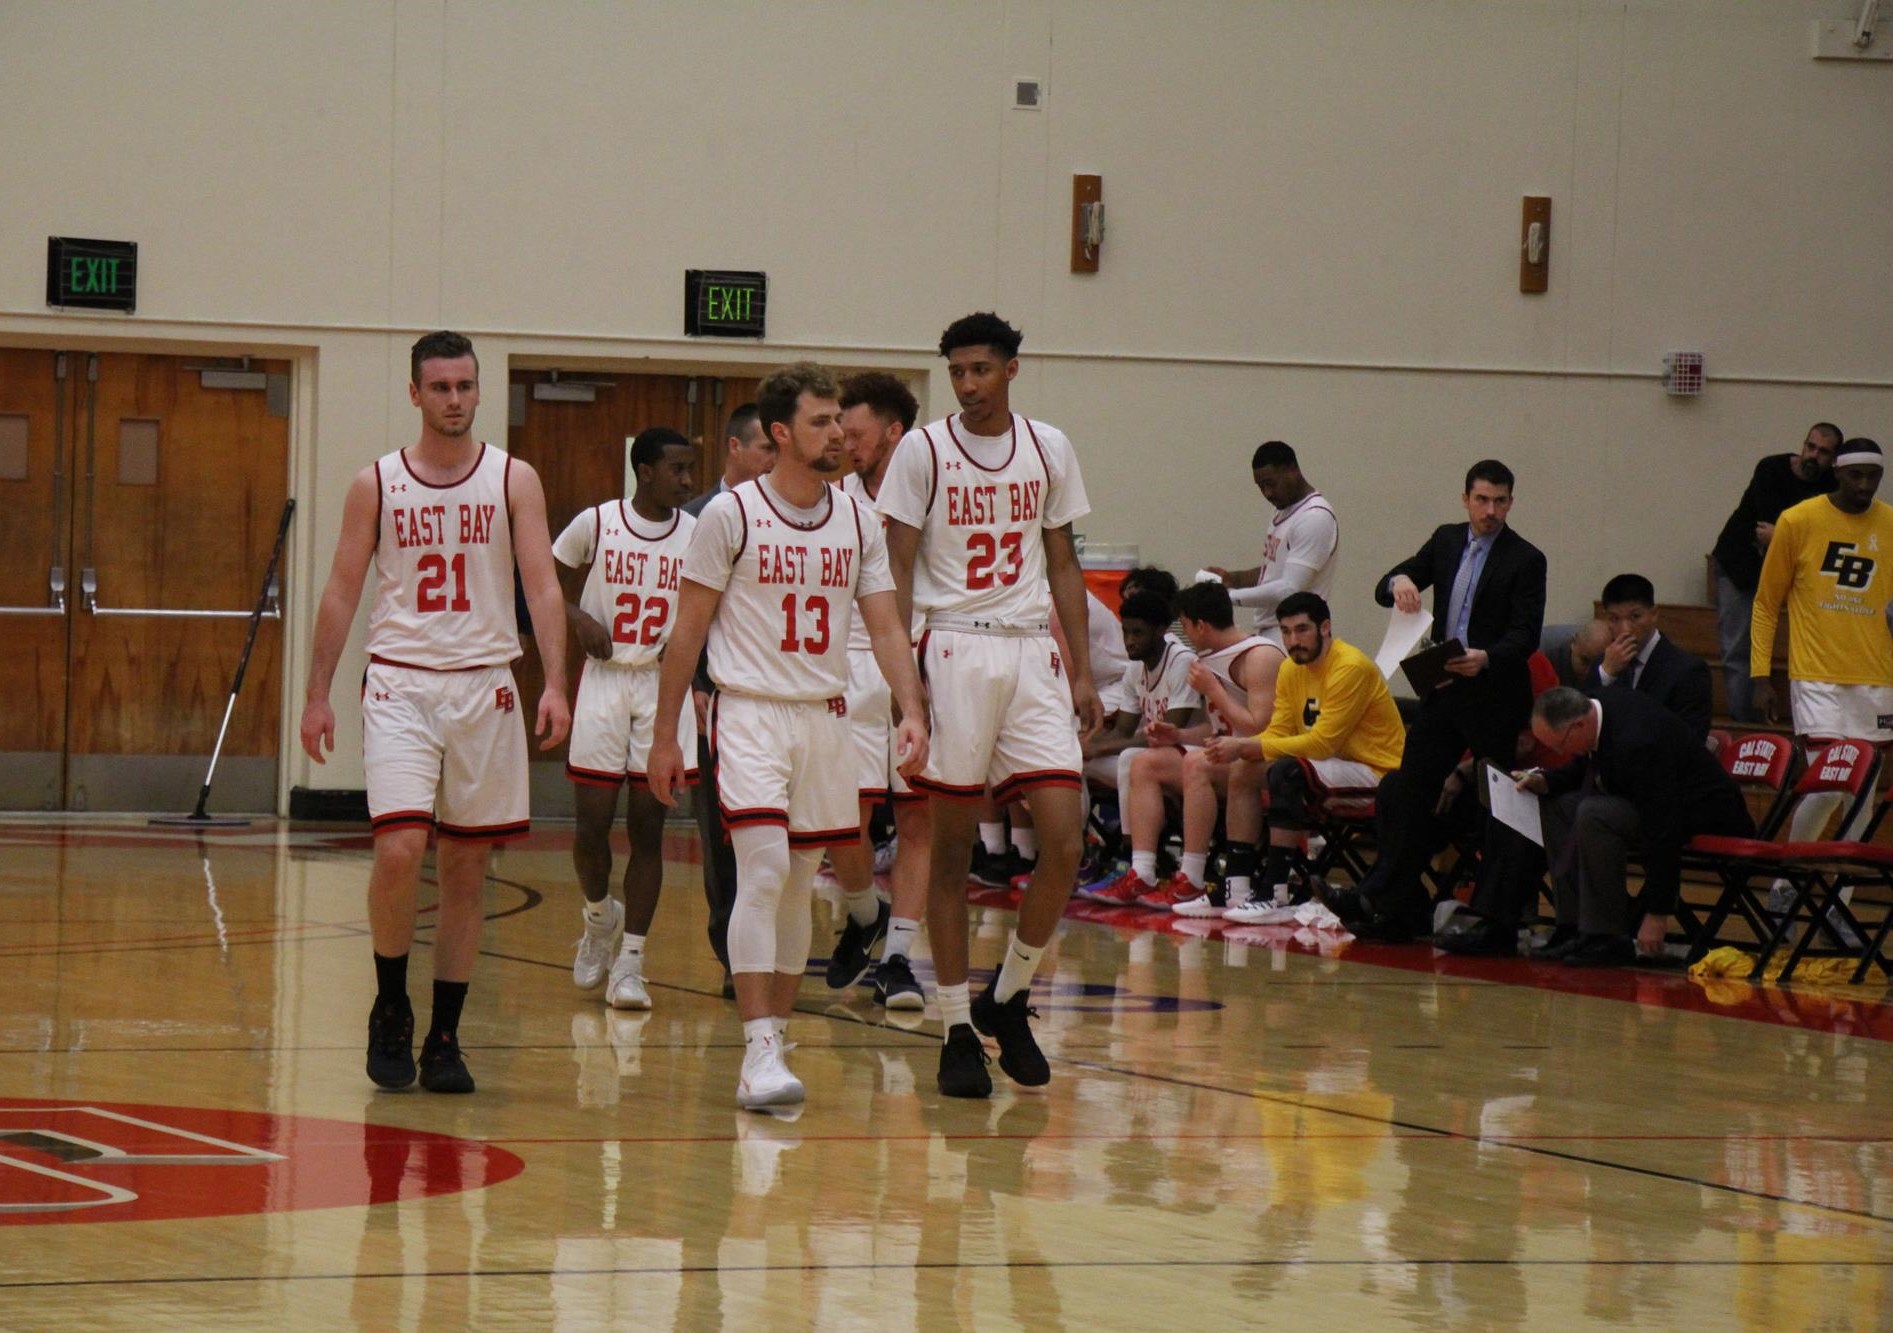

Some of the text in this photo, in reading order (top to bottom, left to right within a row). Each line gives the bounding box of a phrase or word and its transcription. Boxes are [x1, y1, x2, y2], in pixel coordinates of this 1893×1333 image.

[71, 256, 119, 293] EXIT
[708, 286, 755, 320] EXIT
[947, 480, 1041, 525] EAST BAY
[393, 504, 496, 548] EAST BAY
[605, 550, 648, 586] EAST
[758, 544, 852, 587] EAST BAY
[966, 531, 1024, 590] 23
[1819, 541, 1877, 592] EB
[417, 553, 471, 613] 21
[612, 592, 669, 646] 22
[781, 593, 830, 655] 13
[1732, 760, 1771, 777] EAST BAY
[1739, 739, 1777, 761] CAL STATE
[1819, 766, 1840, 781] EAST
